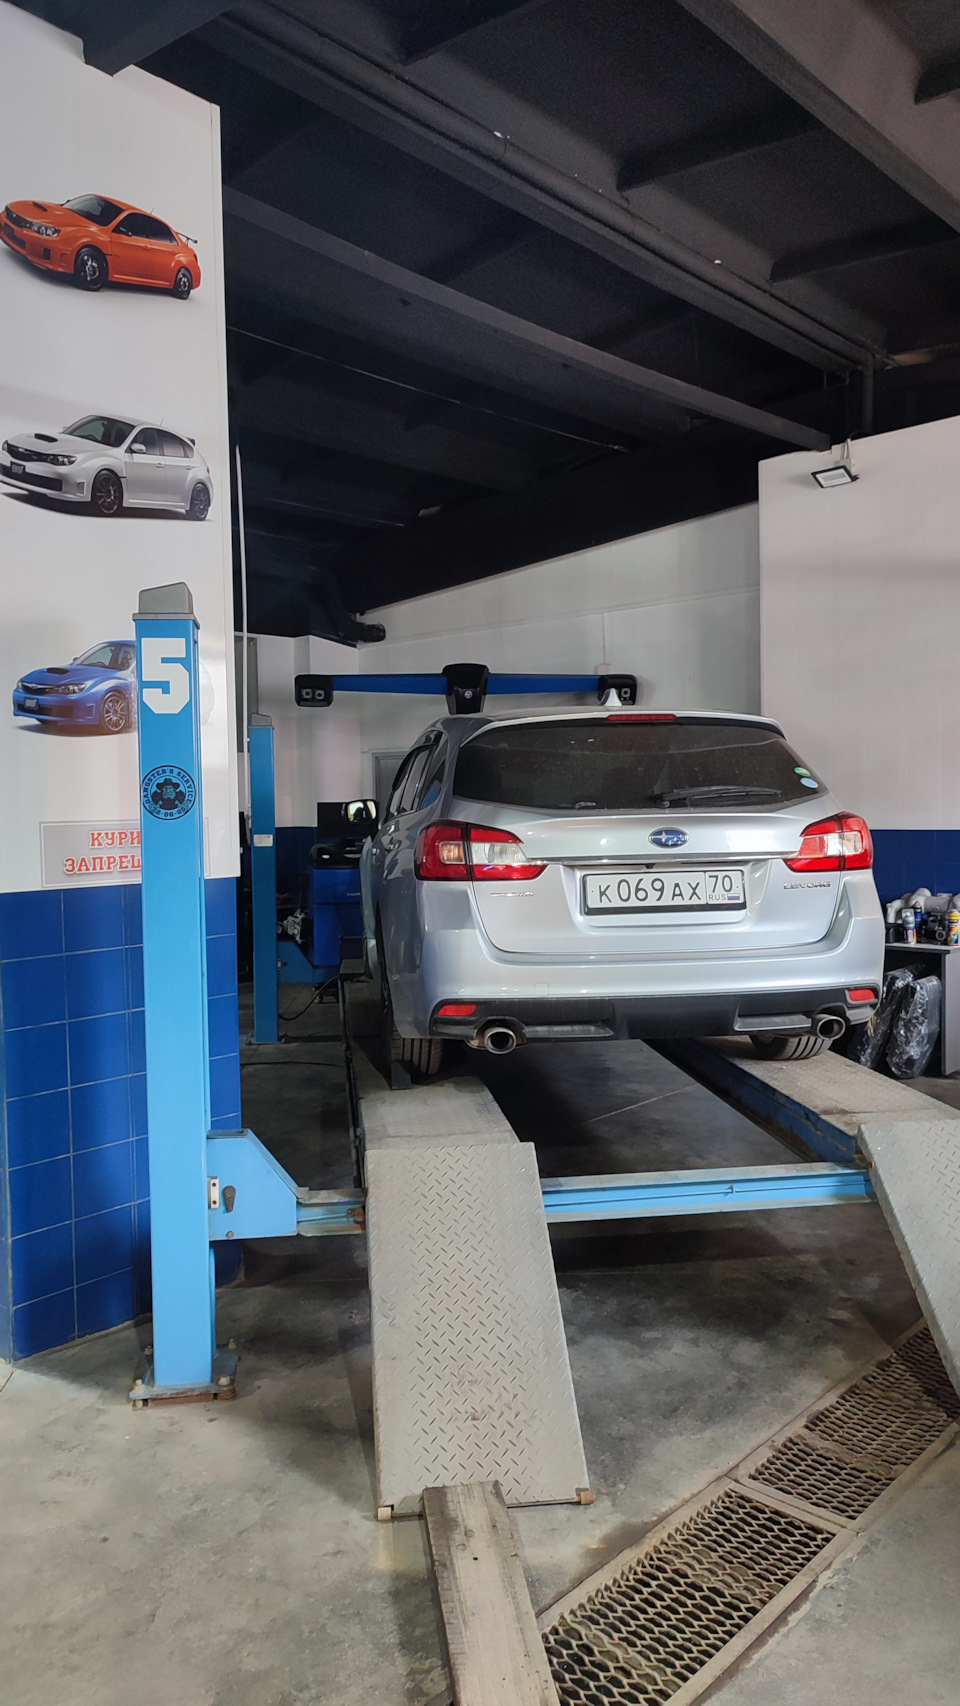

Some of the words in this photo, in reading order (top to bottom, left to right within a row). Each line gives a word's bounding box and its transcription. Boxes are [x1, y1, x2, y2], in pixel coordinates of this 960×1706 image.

[141, 637, 190, 714] 5
[176, 771, 194, 804] SERVICE
[90, 831, 141, 847] КУРИ
[708, 874, 733, 893] 70
[708, 893, 727, 901] RUS
